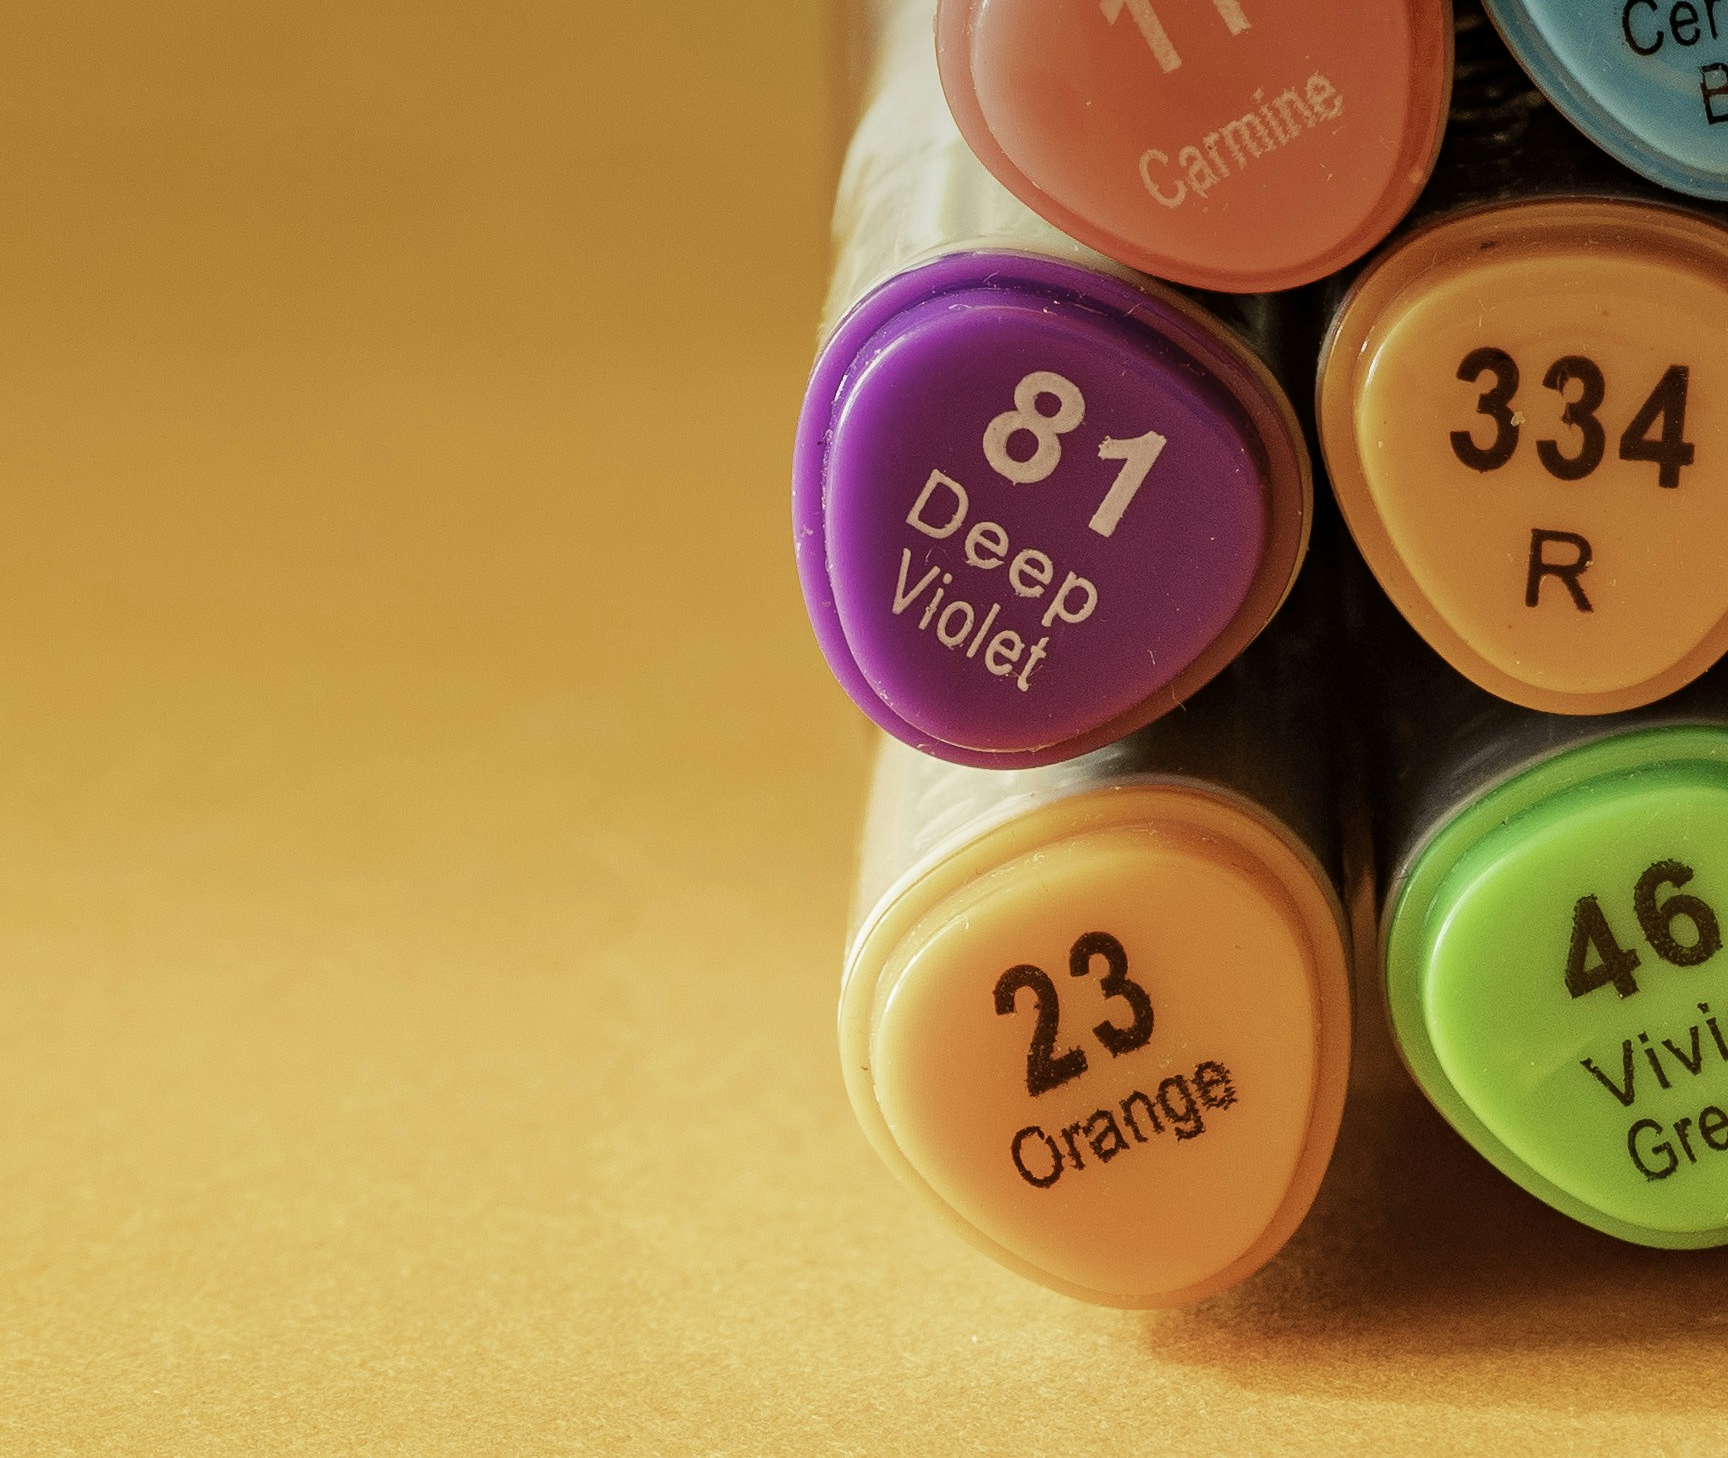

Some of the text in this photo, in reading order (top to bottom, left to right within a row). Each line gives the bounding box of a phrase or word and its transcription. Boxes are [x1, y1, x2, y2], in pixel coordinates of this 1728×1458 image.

[1138, 70, 1342, 209] Carmine
[982, 370, 1167, 537] 81
[1449, 347, 1695, 488] 334
[905, 469, 1098, 627] Deep
[1526, 528, 1594, 613] R
[892, 548, 1050, 692] Violet
[1565, 858, 1723, 1000] 46
[993, 930, 1155, 1098] 23
[1010, 1060, 1239, 1188] Orange
